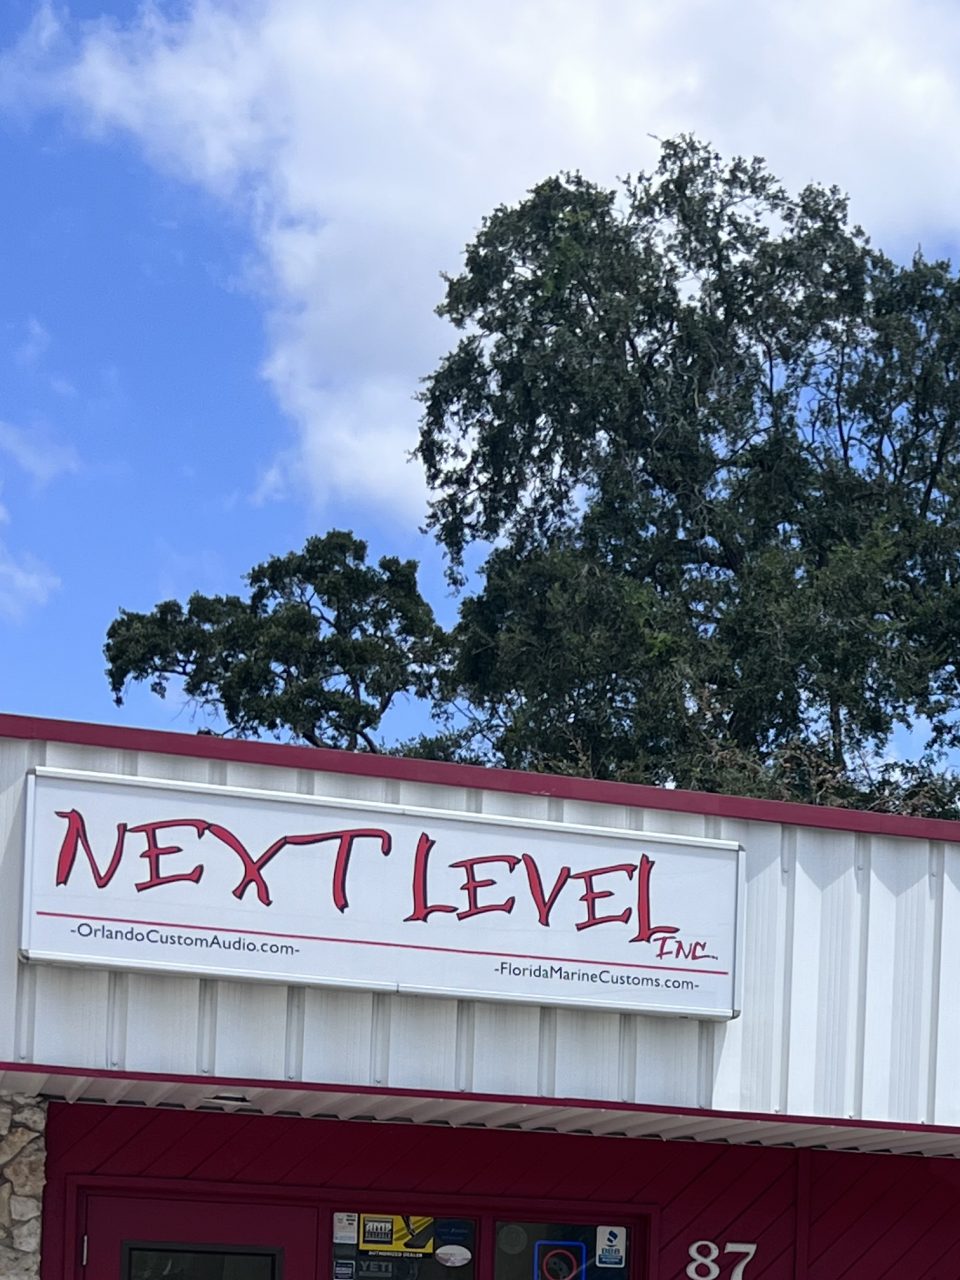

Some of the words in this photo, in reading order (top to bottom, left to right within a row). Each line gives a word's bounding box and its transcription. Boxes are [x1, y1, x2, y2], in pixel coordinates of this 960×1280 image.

[55, 808, 393, 914] NEXT
[403, 832, 681, 943] LEVEL
[360, 1260, 393, 1272] YETI
